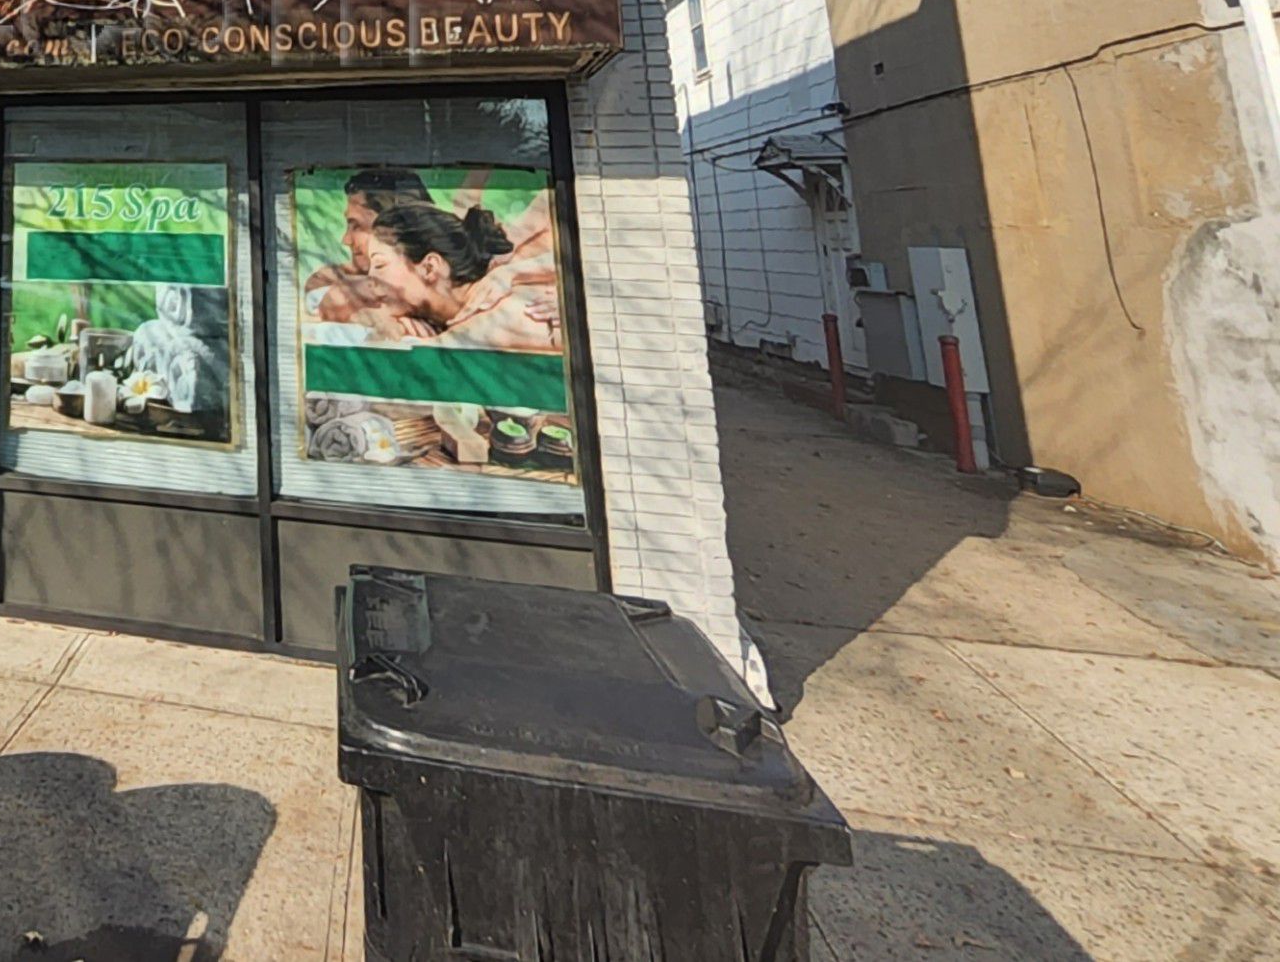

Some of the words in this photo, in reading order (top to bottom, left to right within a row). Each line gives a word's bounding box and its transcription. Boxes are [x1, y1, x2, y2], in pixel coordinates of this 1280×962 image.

[420, 11, 571, 45] BEAUTY
[48, 183, 115, 220] 215
[120, 183, 200, 232] Spa
